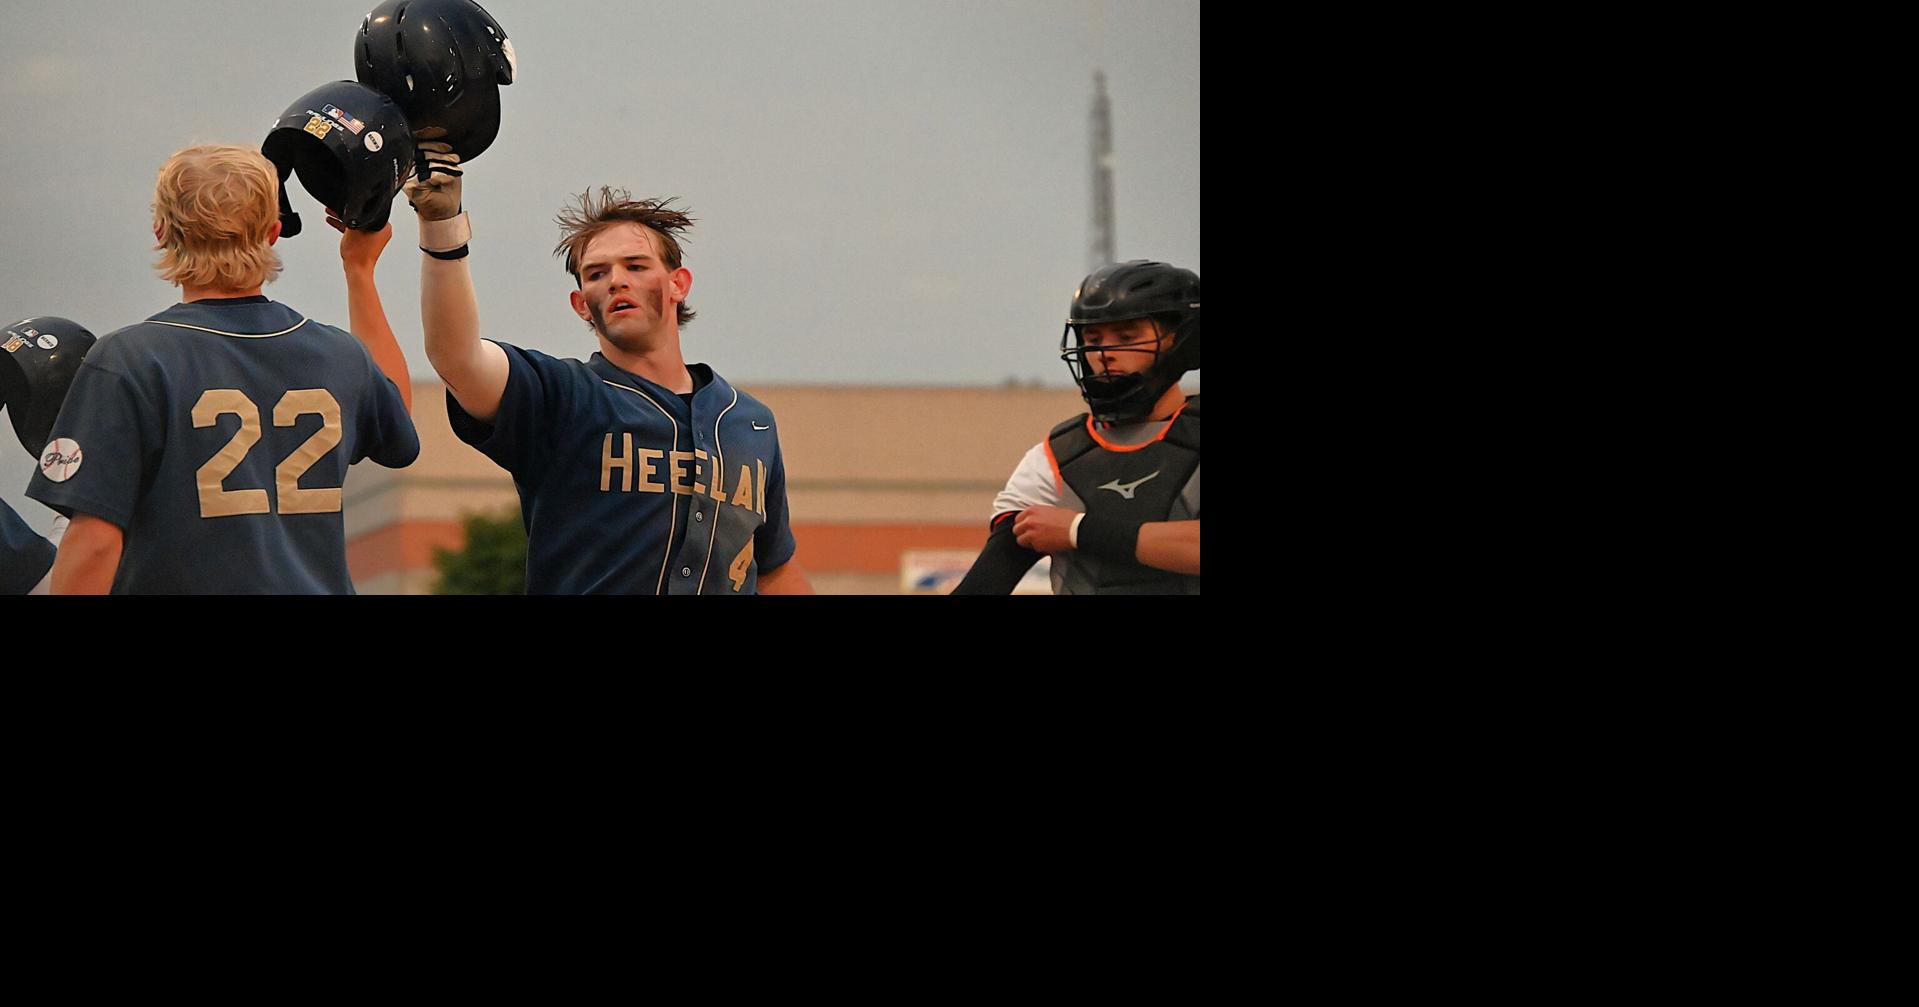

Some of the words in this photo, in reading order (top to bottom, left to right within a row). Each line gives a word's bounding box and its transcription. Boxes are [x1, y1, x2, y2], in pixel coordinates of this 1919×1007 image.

[303, 116, 333, 140] 22
[191, 388, 342, 518] 22
[728, 534, 754, 593] 4
